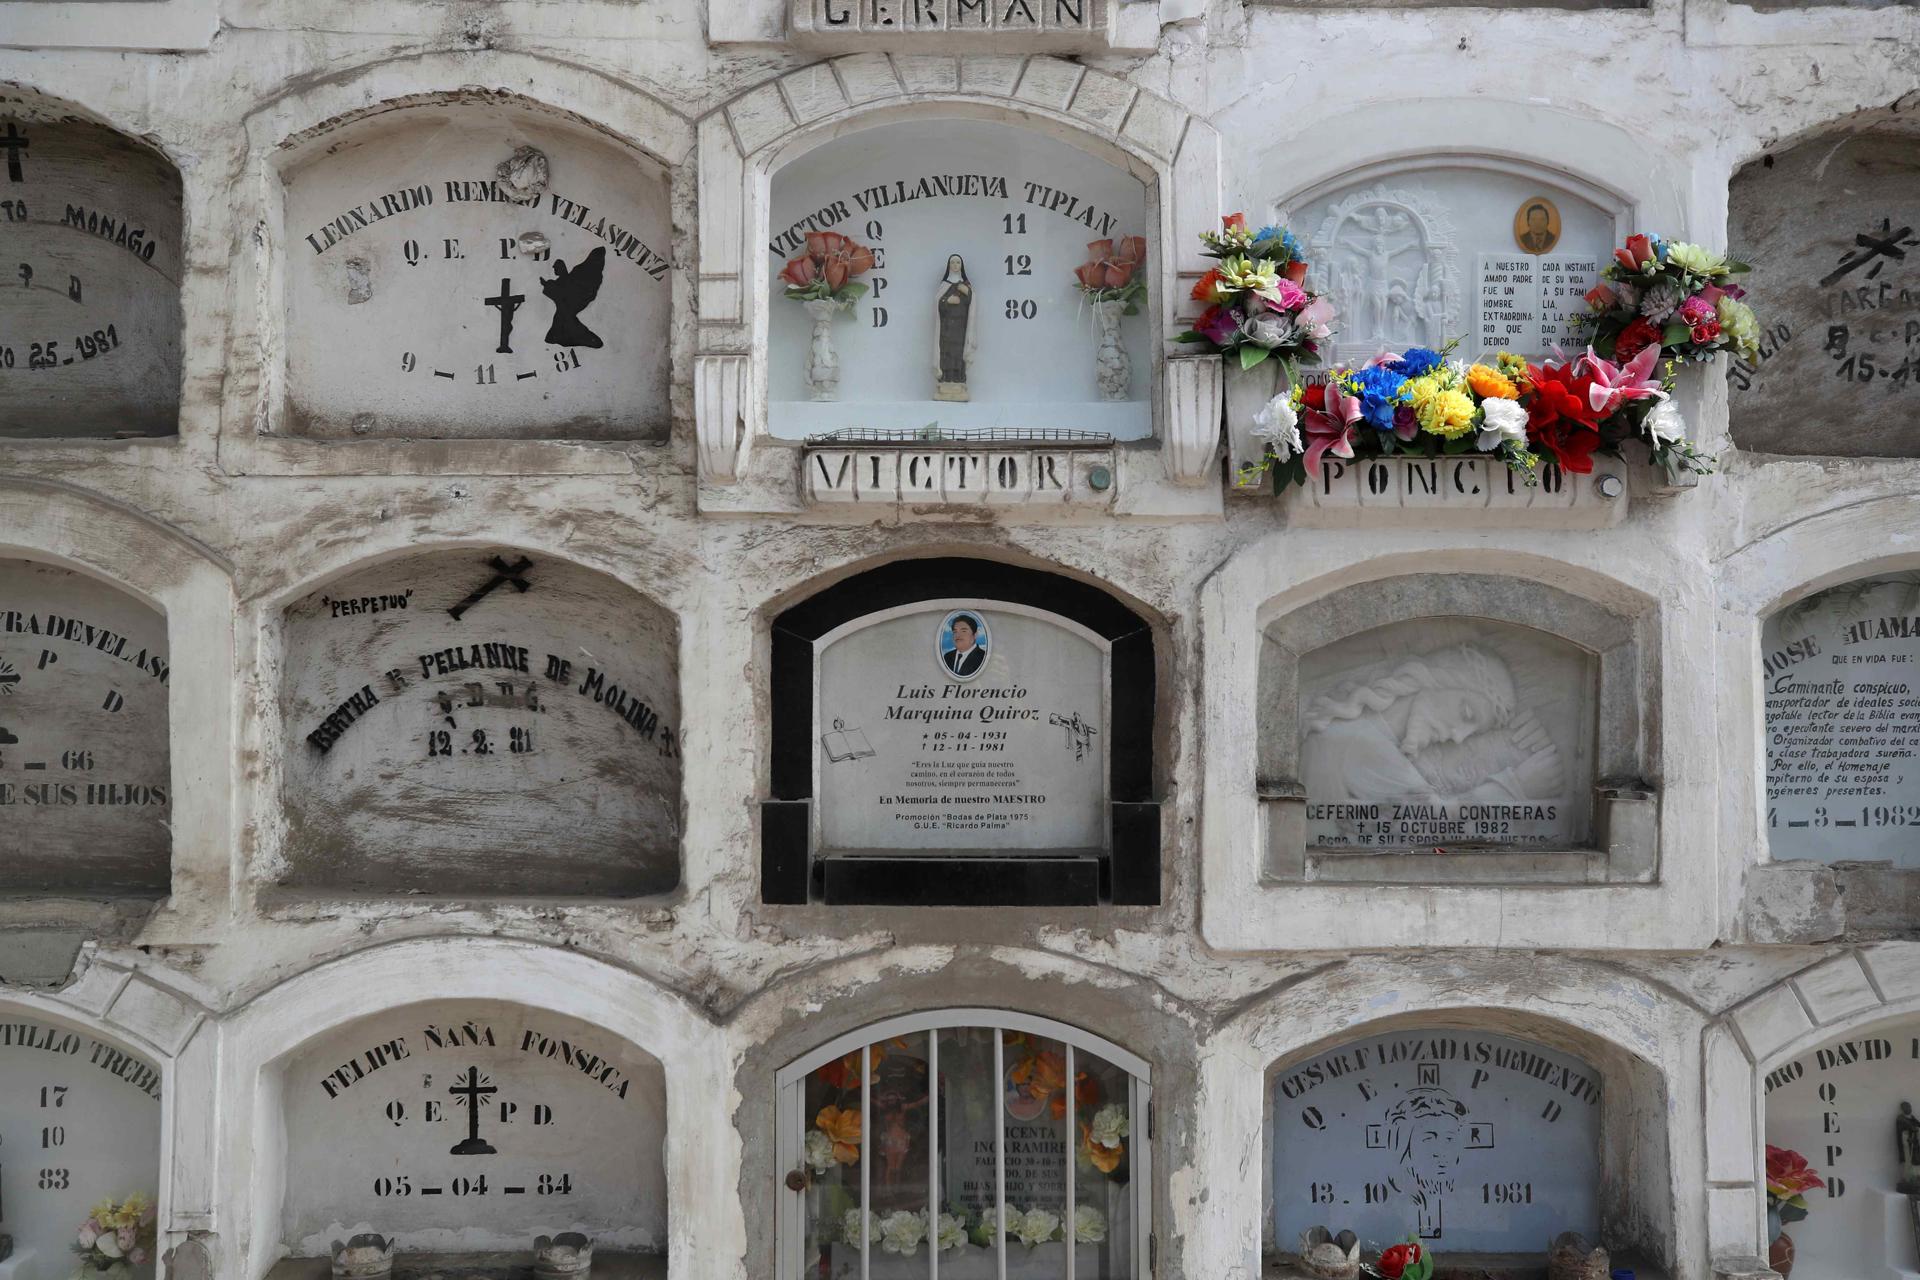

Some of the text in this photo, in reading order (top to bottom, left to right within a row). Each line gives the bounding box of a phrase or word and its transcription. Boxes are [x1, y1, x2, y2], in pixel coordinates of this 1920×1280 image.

[768, 174, 1120, 259] VICTOR VILLANUEVA TIPIAN
[1002, 213, 1027, 235] 11
[305, 183, 671, 282] LEONARDO VELASQUEZ
[865, 220, 883, 240] Q
[870, 248, 885, 269] E
[1004, 254, 1032, 276] 12
[1484, 262, 1529, 271] A NUESTRO
[1542, 263, 1596, 272] CADA INSTANTE
[872, 277, 888, 299] P
[1484, 275, 1533, 283] AMADO PADRE
[1542, 275, 1584, 284] DE SU VIDA
[1483, 286, 1515, 295] FUE UN
[1543, 287, 1548, 296] A
[1554, 287, 1564, 296] SU
[1005, 299, 1038, 320] 80
[1483, 299, 1513, 308] HOMBRE
[872, 306, 888, 328] D
[1542, 312, 1564, 322] A LA
[1483, 324, 1522, 334] RIO QUE
[1541, 325, 1556, 334] DAD
[1483, 337, 1510, 346] DEDICO
[1542, 337, 1552, 347] SU
[401, 347, 582, 386] 9 11 81
[816, 454, 1062, 490] VICTOR
[1323, 460, 1563, 495] PONCIO
[37, 649, 58, 671] P
[1763, 634, 1822, 680] JOSE
[1832, 655, 1886, 665] QUE EN VIDA
[896, 684, 1027, 699] Luis Florencio
[1769, 673, 1845, 695] Caminante
[102, 689, 124, 713] D
[306, 684, 381, 753] BERTHA
[546, 654, 572, 685] DE
[579, 667, 659, 742] MOLINA
[1837, 697, 1893, 708] de ideales
[884, 705, 1040, 724] Marquina Quiroz
[1808, 710, 1895, 720] lector de la Biblia
[934, 732, 1007, 740] 05 04 1931
[1839, 725, 1872, 733] severo
[1875, 723, 1889, 733] del
[932, 743, 1005, 751] 12 11 1981
[1773, 733, 1834, 749] Organizador
[1890, 736, 1905, 746] del
[61, 750, 95, 771] 66
[1779, 749, 1807, 758] clase
[949, 770, 956, 778] el
[986, 770, 995, 778] de
[996, 770, 1015, 778] todos
[956, 762, 969, 770] que
[1771, 758, 1792, 771] Por
[1824, 761, 1834, 770] el
[1838, 762, 1891, 774] Homenaje
[938, 780, 965, 788] siempre
[1818, 773, 1830, 783] de
[1834, 774, 1848, 783] su
[1854, 775, 1889, 786] esposa
[1896, 775, 1904, 784] y
[23, 783, 167, 806] SUS HIJOS
[879, 794, 1046, 805] En Memoria de nuestro MAESTRO
[895, 813, 940, 821] Promoción
[975, 813, 985, 821] de
[987, 813, 1008, 821] Plata
[1010, 813, 1029, 821] 1975
[1306, 804, 1557, 820] CEFERINO ZAVALA CONTRERAS
[1814, 806, 1829, 827] 3
[1862, 805, 1920, 827] 1982
[1376, 821, 1510, 834] 15 OCTUBRE 1982
[320, 1021, 630, 1100] FELIPE ÑAÑA FONSECA
[1377, 1038, 1471, 1064] LOZADA
[1816, 1039, 1892, 1070] DAVID
[39, 1086, 69, 1108] 17
[1819, 1082, 1836, 1105] Q
[1541, 1100, 1562, 1123] D
[1824, 1112, 1840, 1133] E
[41, 1126, 65, 1149] 10
[1004, 1126, 1056, 1139] ICENTA
[1012, 1141, 1067, 1153] RAMIRE
[1826, 1145, 1843, 1166] P
[38, 1168, 70, 1190] 83
[374, 1173, 572, 1197] 05 04 84
[1828, 1176, 1845, 1198] D
[1364, 1182, 1388, 1204] 10
[1482, 1182, 1533, 1204] 1981
